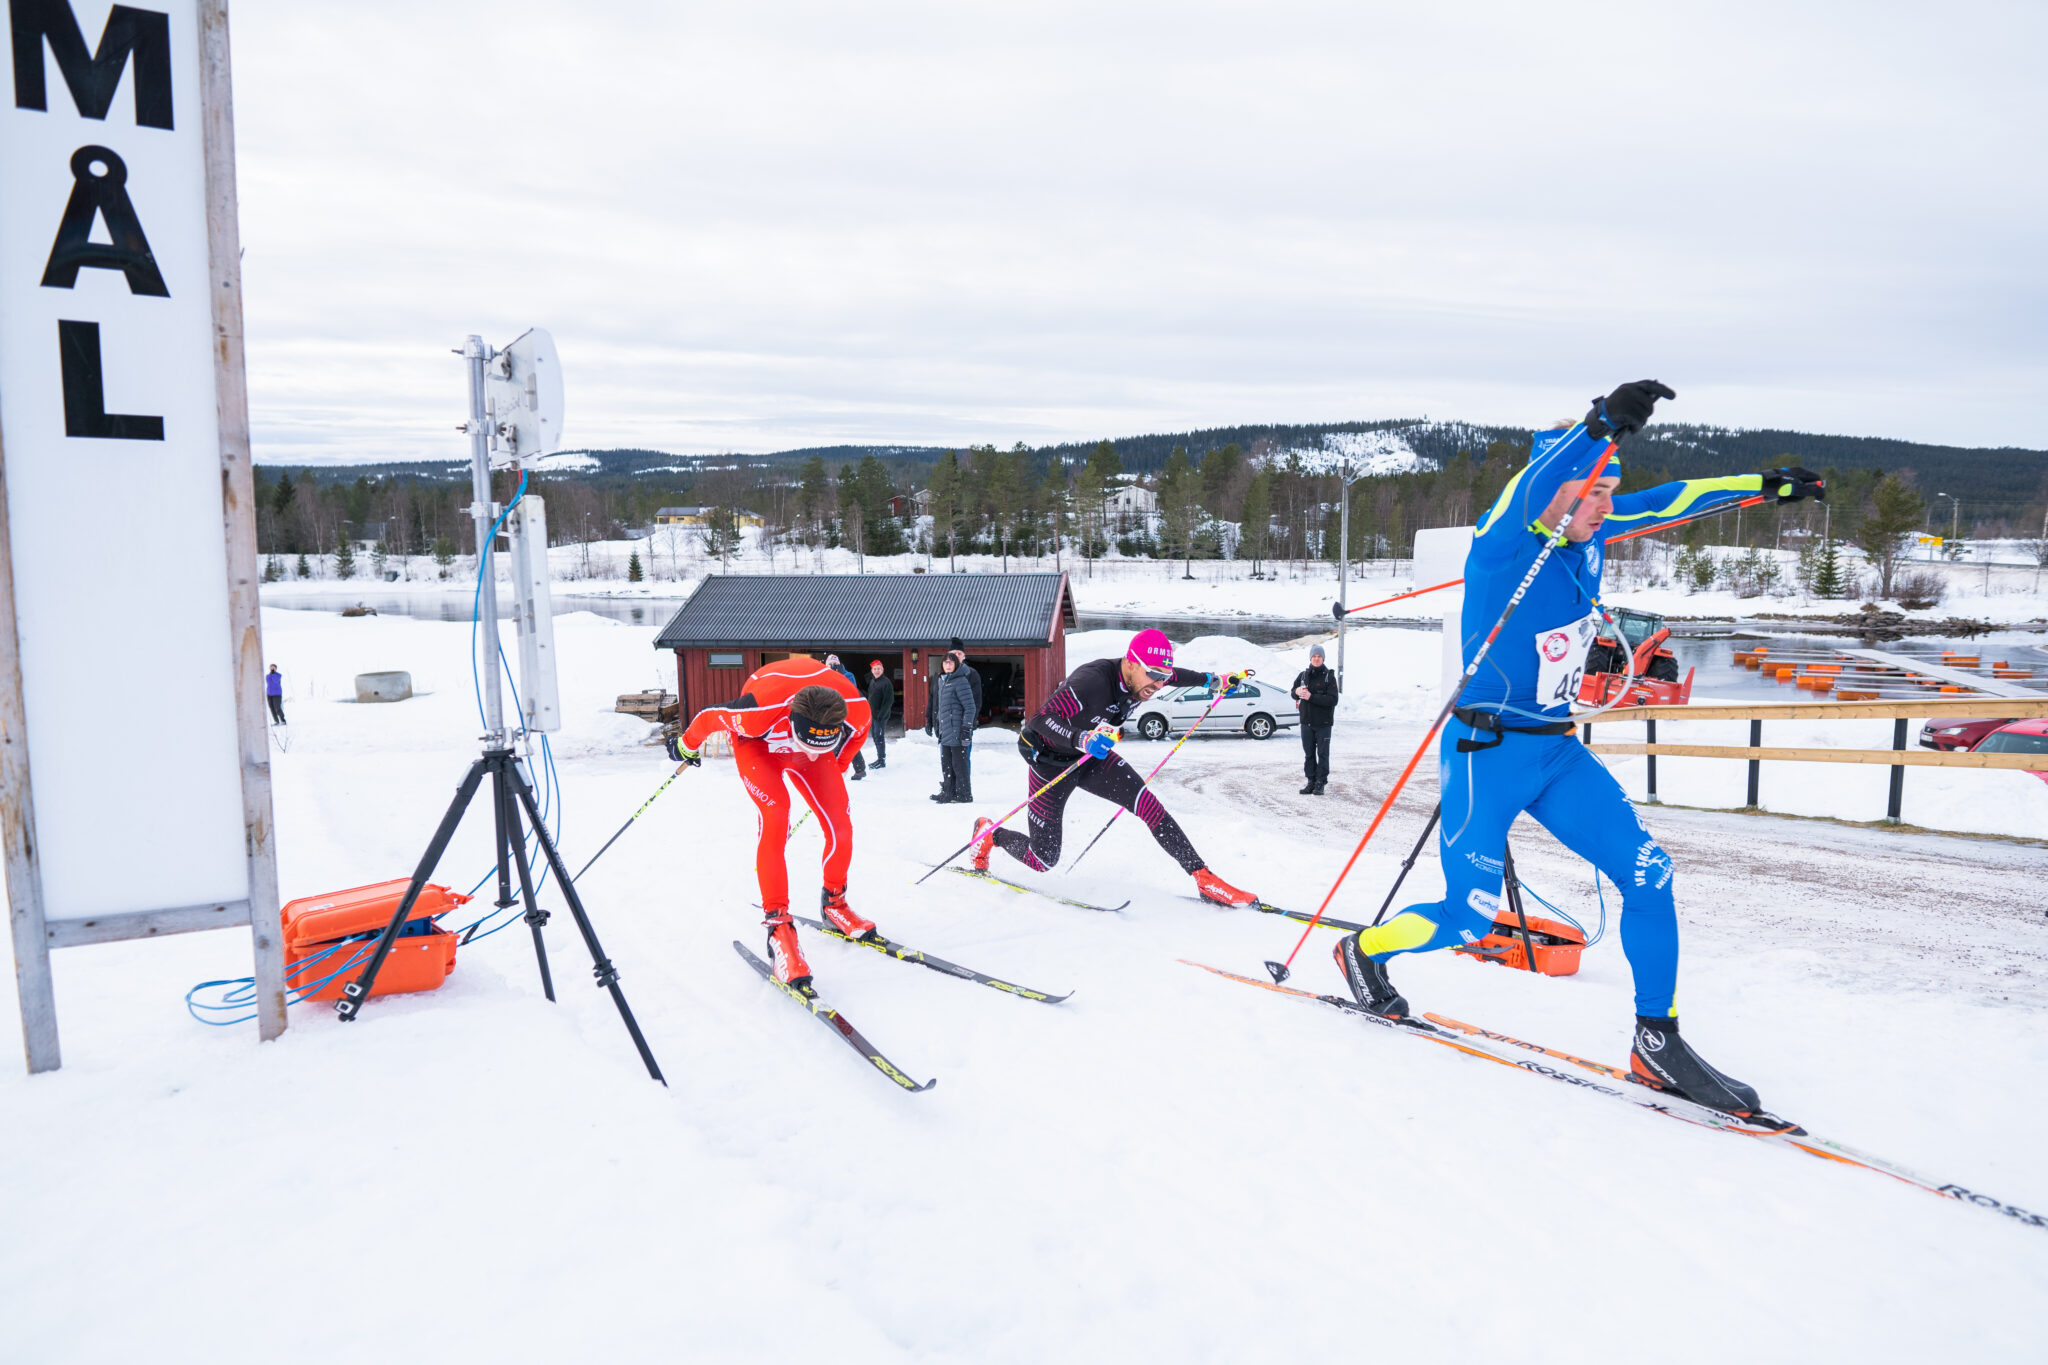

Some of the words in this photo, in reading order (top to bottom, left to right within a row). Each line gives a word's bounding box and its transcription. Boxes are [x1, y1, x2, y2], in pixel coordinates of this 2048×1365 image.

[8, 0, 174, 441] MÅL
[1510, 513, 1573, 605] ROSSIGNOL
[1346, 940, 1376, 1005] ROSSIGNOL
